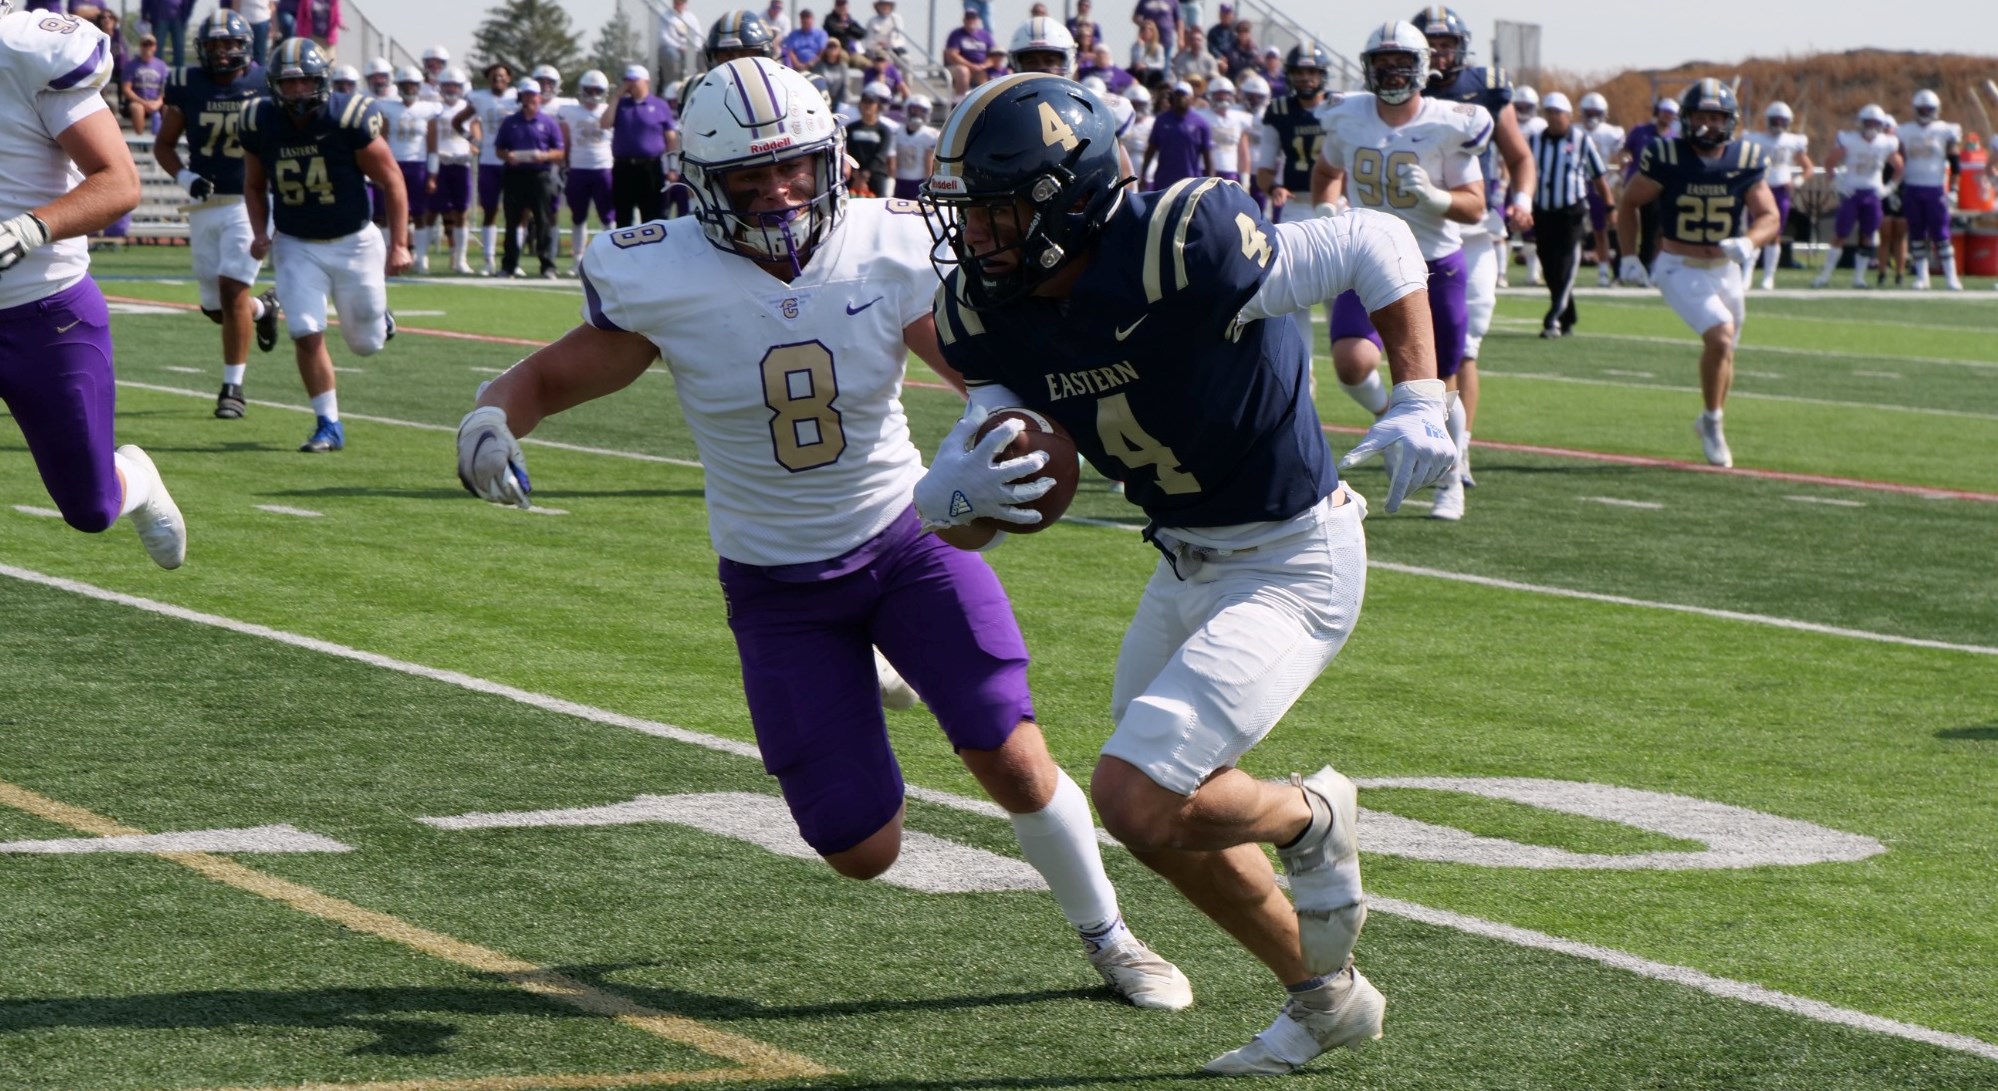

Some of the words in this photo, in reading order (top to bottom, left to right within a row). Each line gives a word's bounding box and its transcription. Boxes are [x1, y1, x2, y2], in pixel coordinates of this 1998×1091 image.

[368, 111, 383, 140] 6
[751, 137, 791, 153] Riddell
[1038, 101, 1079, 152] 4
[280, 145, 319, 159] EASTERN
[276, 157, 336, 206] 64
[1353, 147, 1419, 209] 98
[1686, 184, 1727, 196] EASTERN
[610, 223, 667, 249] 8
[1234, 212, 1272, 268] 4
[1676, 195, 1735, 243] 25
[1045, 360, 1140, 401] EASTERN
[759, 338, 848, 474] 8
[1096, 392, 1201, 495] 4
